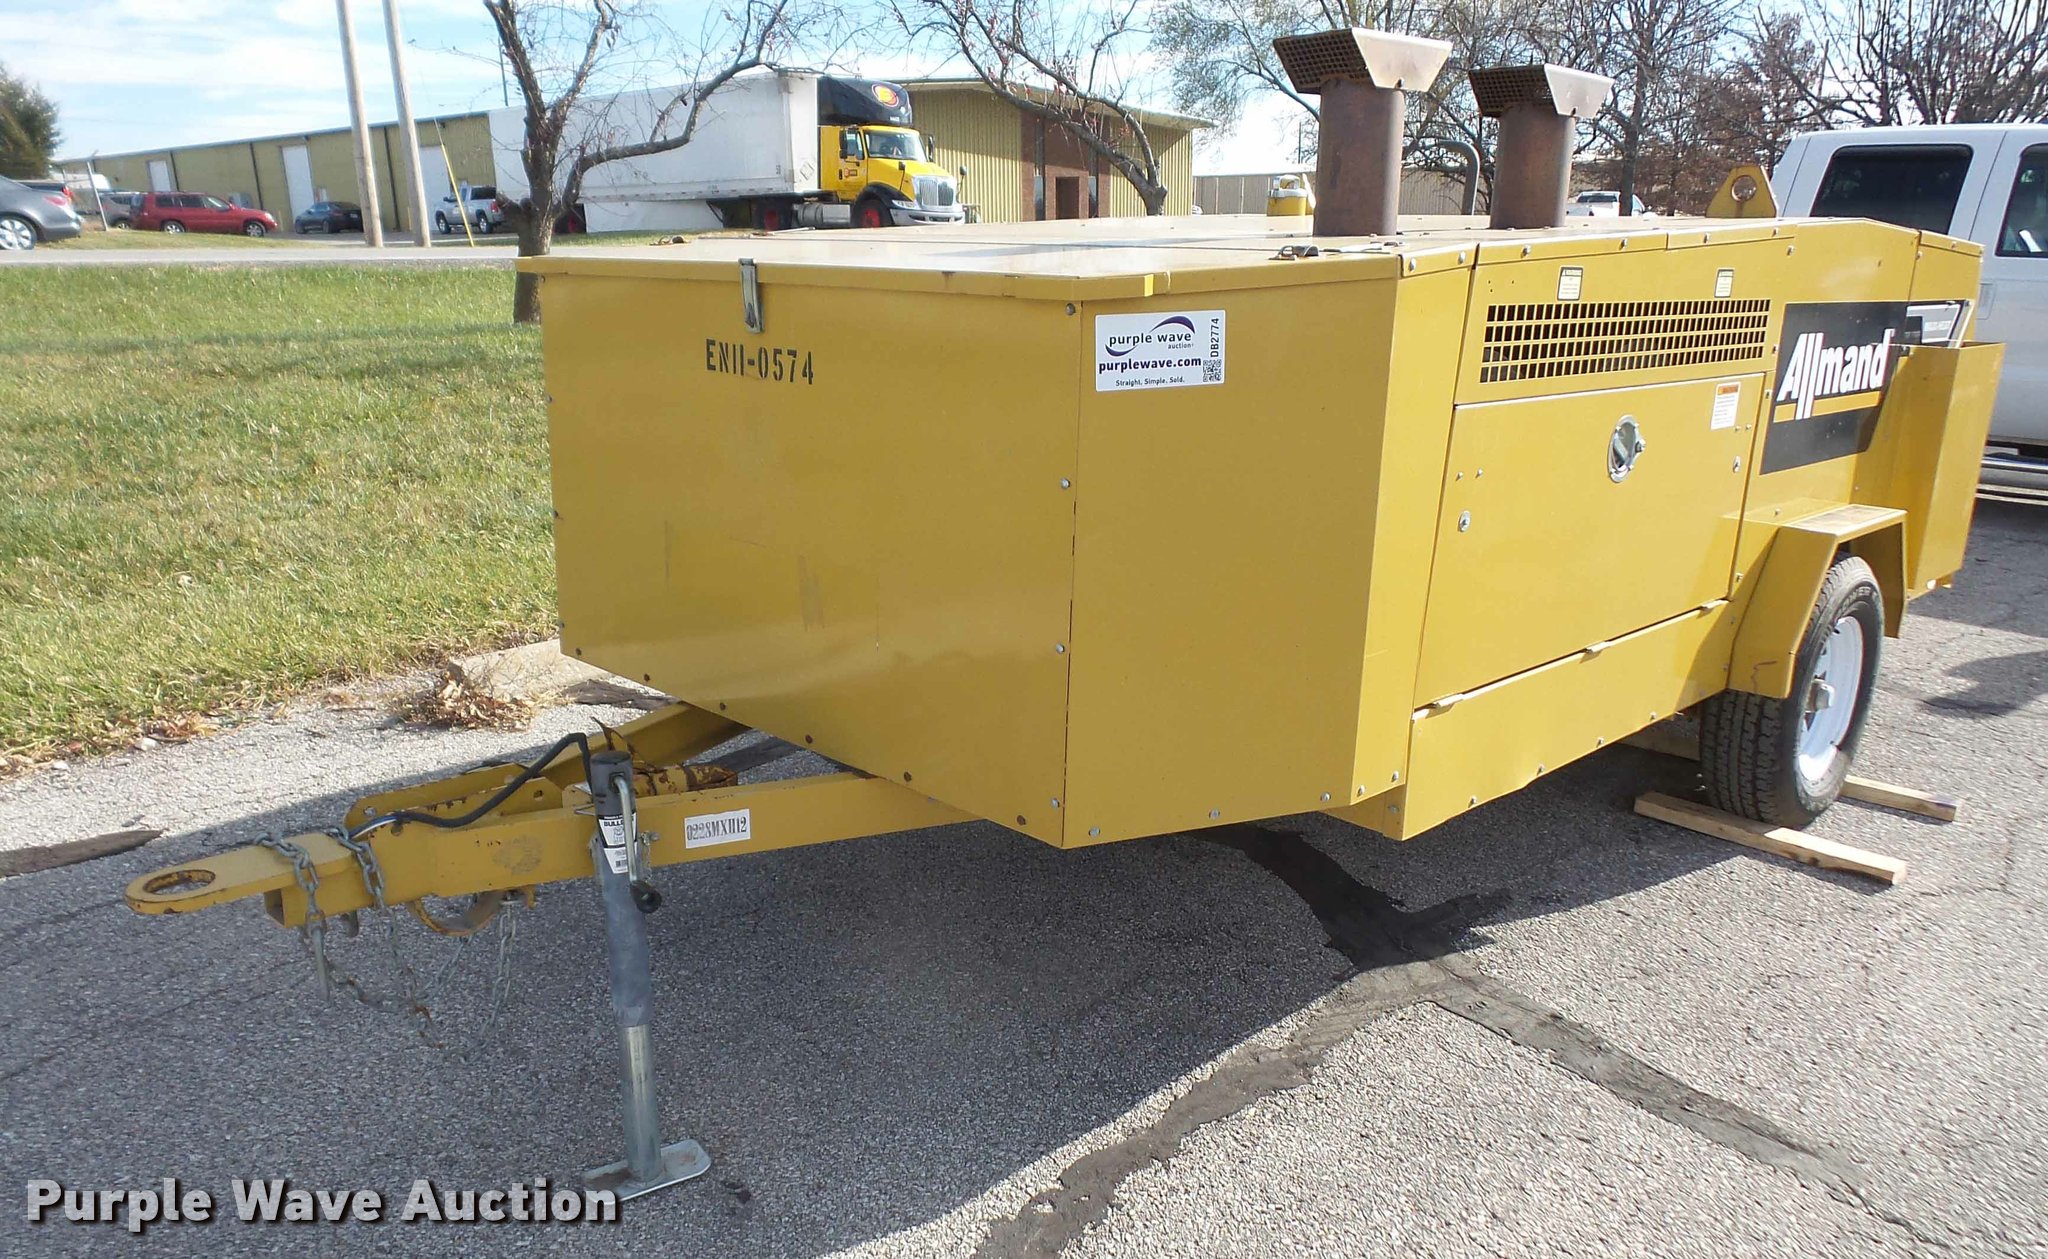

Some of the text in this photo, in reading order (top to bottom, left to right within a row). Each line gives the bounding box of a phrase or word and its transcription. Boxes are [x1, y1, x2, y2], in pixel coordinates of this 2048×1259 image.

[1109, 332, 1191, 348] purple wave
[1210, 318, 1220, 357] DB2774
[1099, 357, 1201, 374] purplewave.com
[1776, 328, 1896, 420] Allmand
[1115, 376, 1185, 387] Straight. Simple. Sold.
